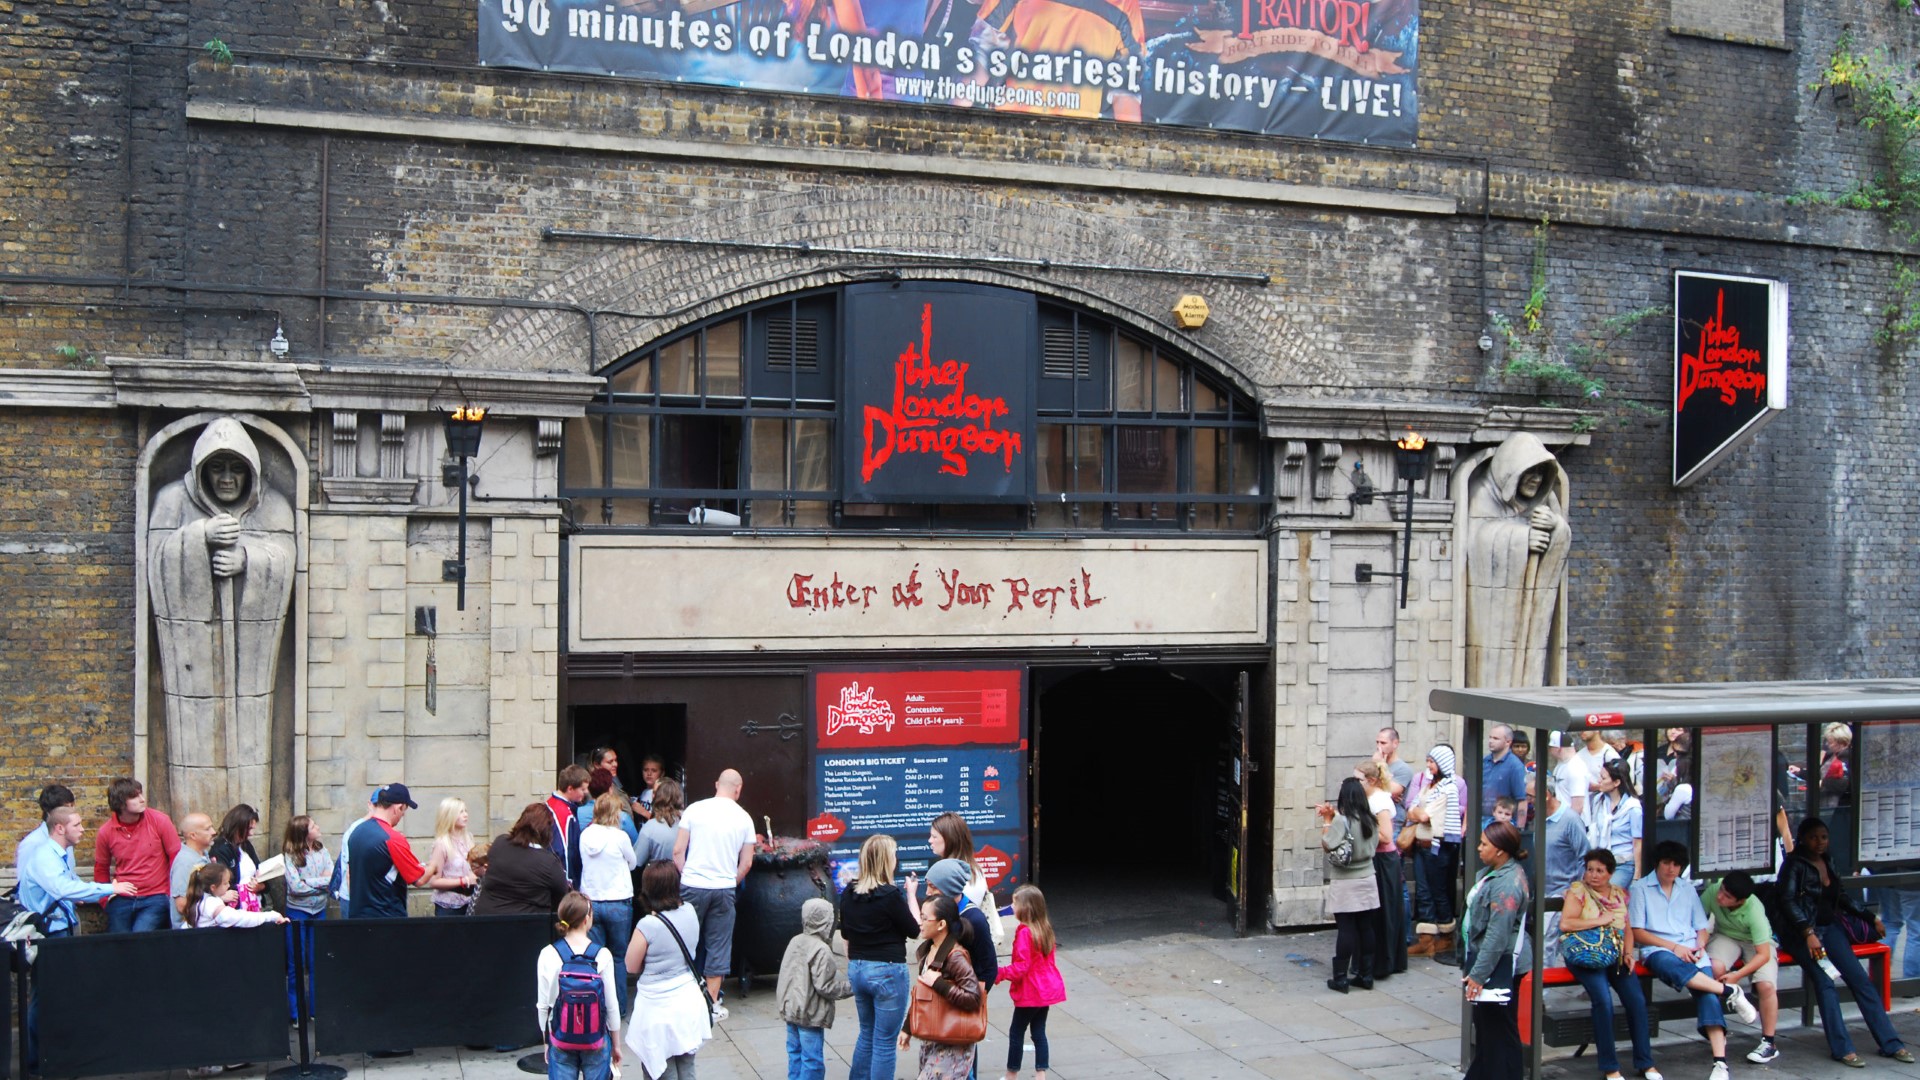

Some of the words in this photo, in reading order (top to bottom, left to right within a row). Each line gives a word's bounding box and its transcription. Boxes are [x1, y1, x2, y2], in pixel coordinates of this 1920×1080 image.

[501, 0, 551, 36] 90
[568, 5, 733, 52] minutes
[749, 21, 792, 56] of
[807, 23, 974, 74] London's
[990, 48, 1142, 93] scariest
[1154, 57, 1278, 109] history
[1321, 76, 1402, 118] LIVE!
[1227, 35, 1267, 56] BOAT
[1271, 34, 1307, 46] RIDE
[1311, 36, 1332, 51] TO
[895, 76, 1081, 109] www.thedungeons.com
[1698, 330, 1761, 371] London
[893, 361, 1010, 430] London
[1678, 353, 1766, 412] Dungeon
[861, 404, 1022, 484] Dungeon
[787, 572, 877, 611] Enter
[892, 563, 923, 611] at
[938, 568, 995, 611] Your
[826, 705, 896, 735] Dungeon
[905, 706, 944, 714] Concession:
[905, 717, 923, 725] Child
